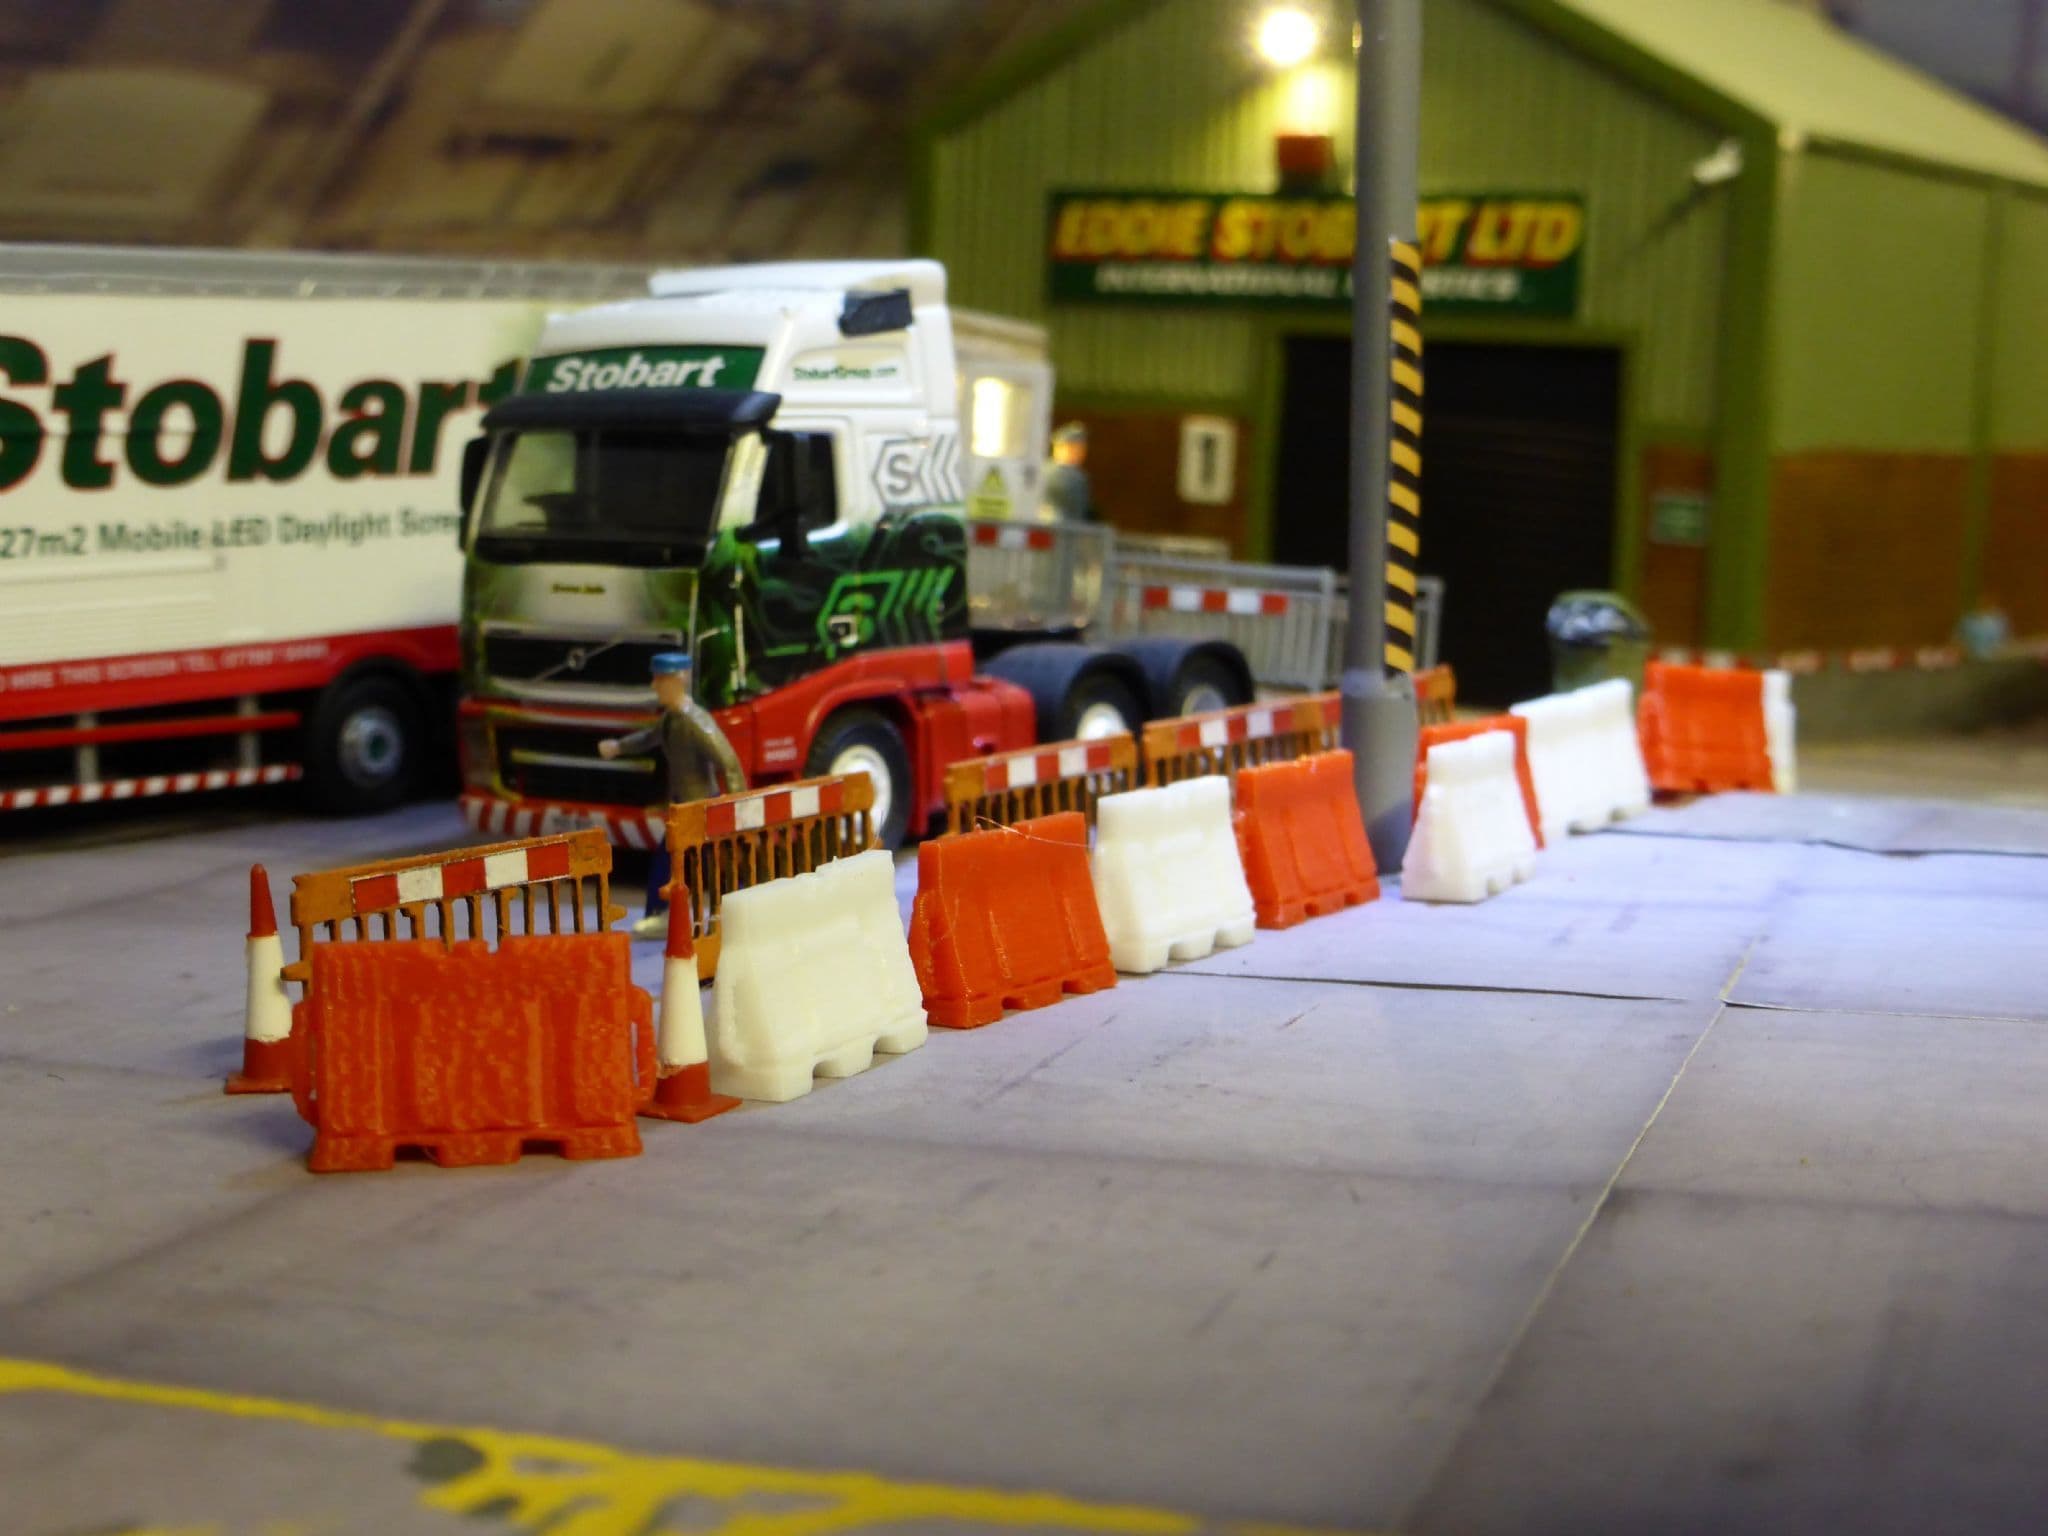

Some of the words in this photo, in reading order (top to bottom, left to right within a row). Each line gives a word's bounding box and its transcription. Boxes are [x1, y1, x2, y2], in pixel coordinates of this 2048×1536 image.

[1465, 201, 1582, 268] LTD
[546, 352, 725, 393] Stobart
[100, 521, 201, 551] Mobile
[211, 514, 271, 547] LED
[277, 510, 392, 547] Daylight
